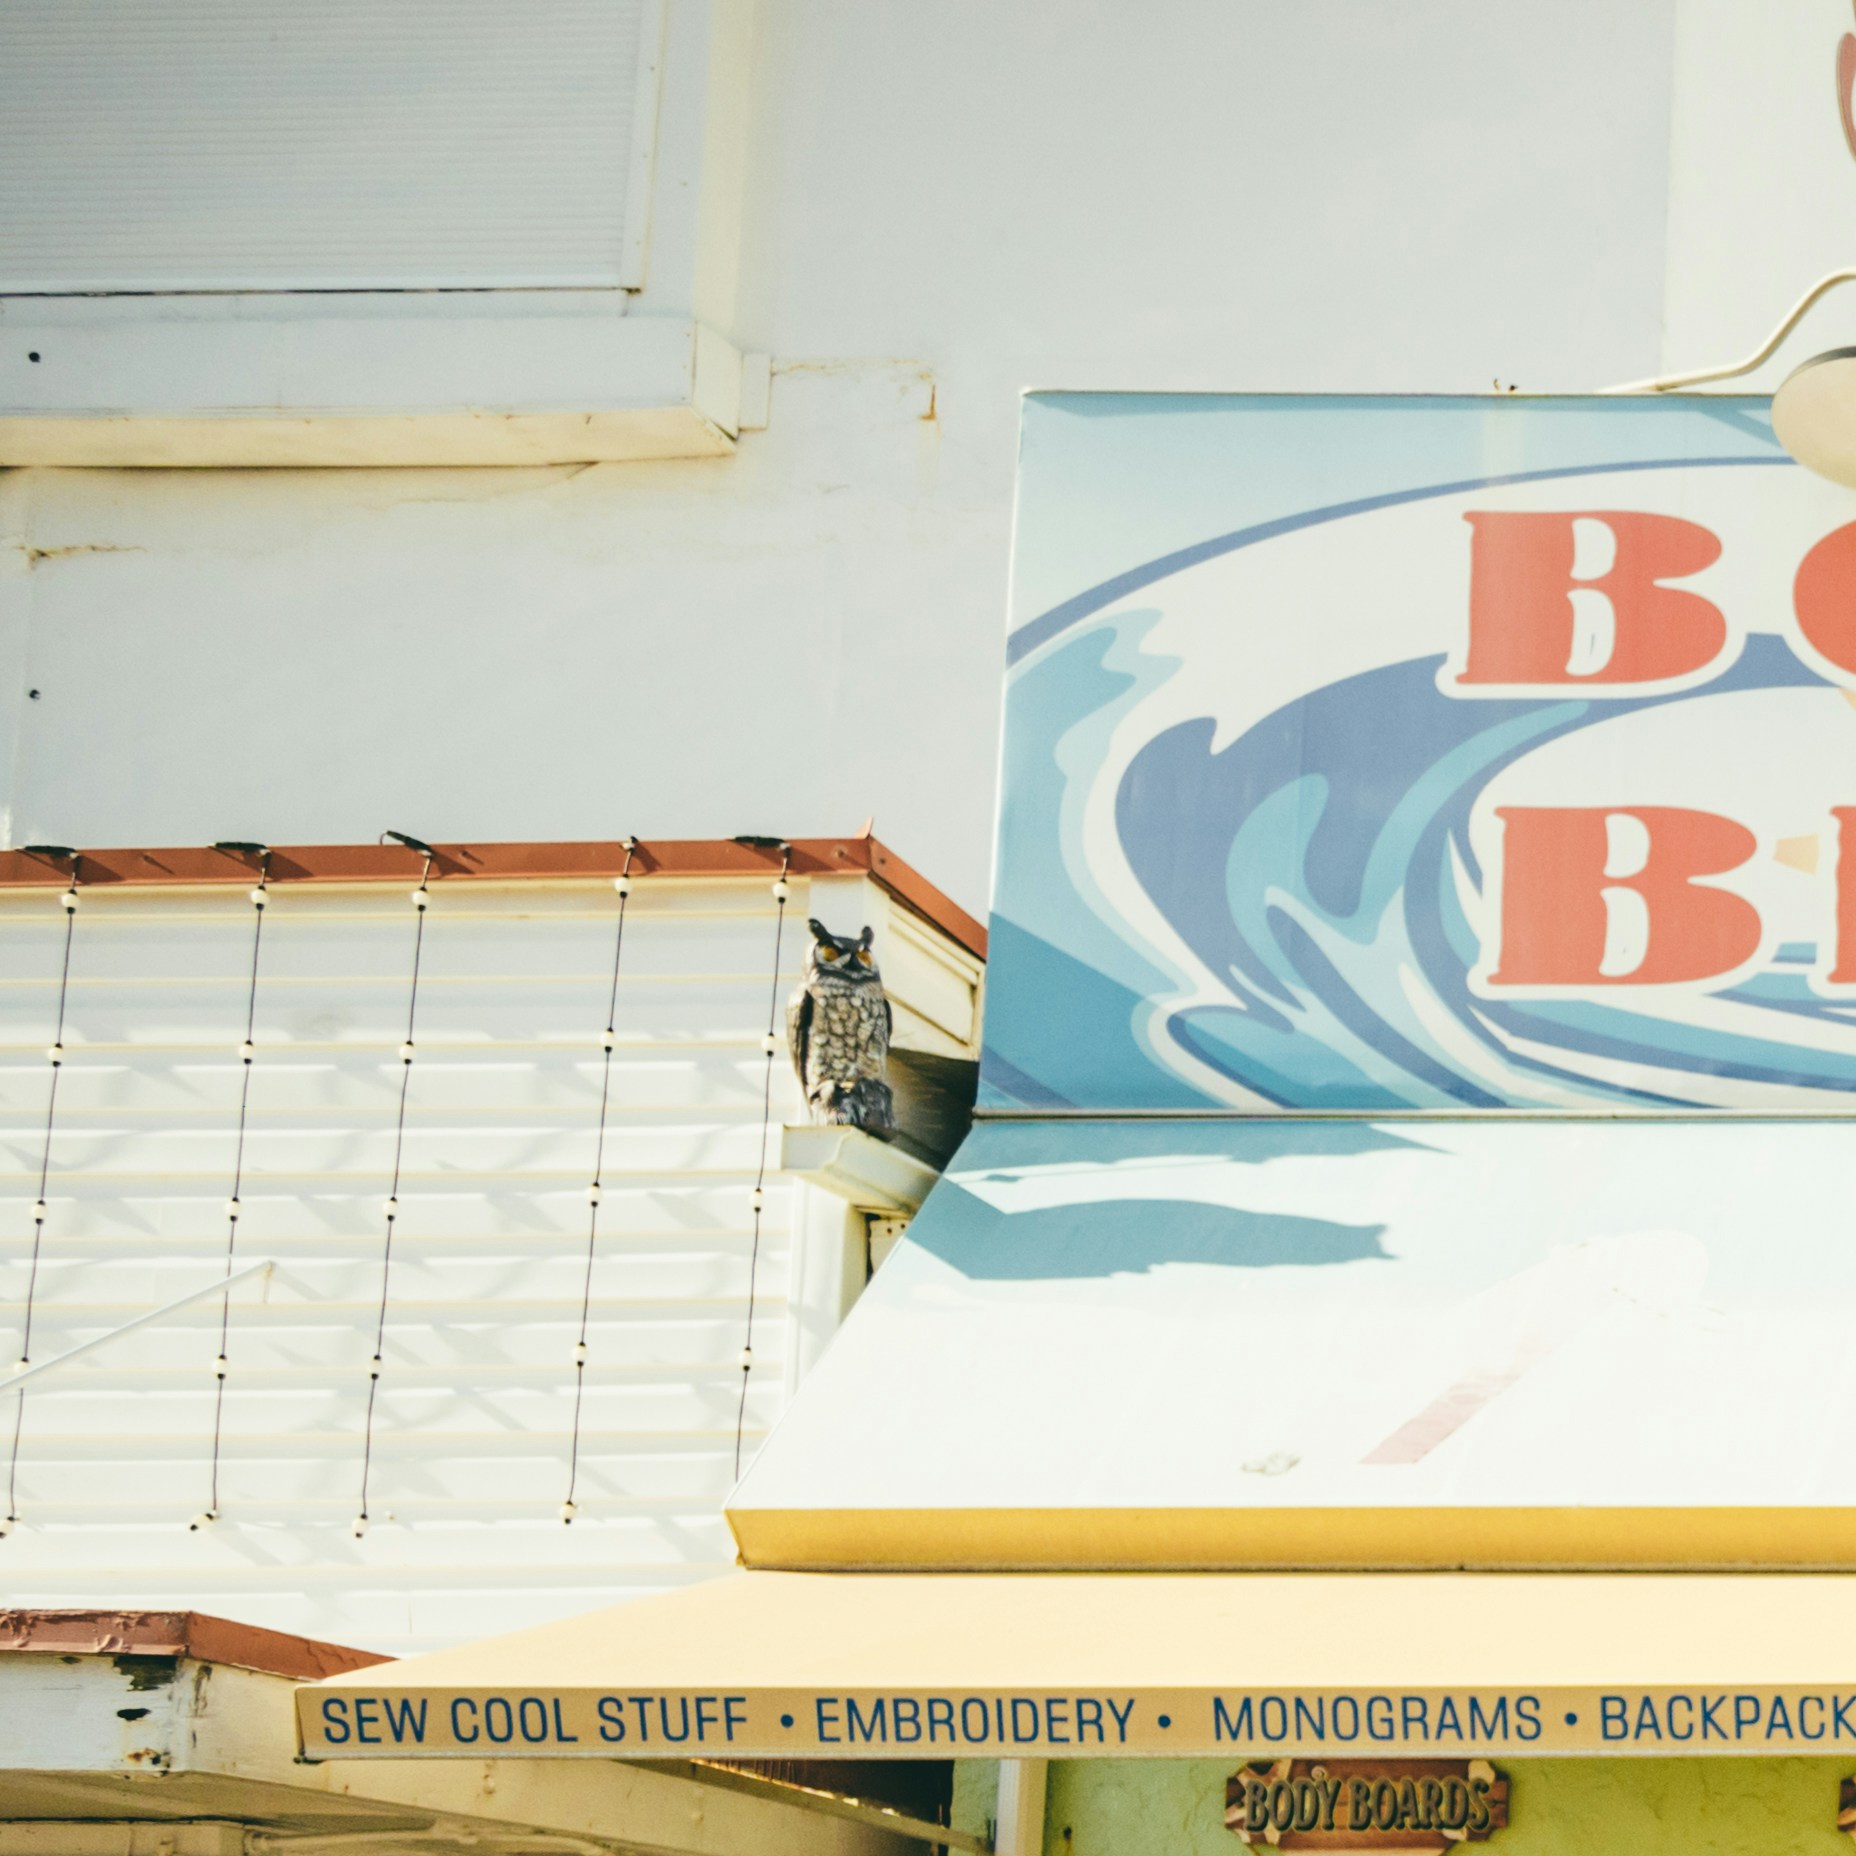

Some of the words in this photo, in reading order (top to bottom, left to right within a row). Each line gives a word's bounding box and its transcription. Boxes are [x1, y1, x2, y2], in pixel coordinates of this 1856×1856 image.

[322, 1697, 428, 1744] SEW
[450, 1696, 578, 1744] COOL
[597, 1696, 746, 1743] STUFF
[815, 1697, 1135, 1744] EMBROIDERY
[1212, 1695, 1543, 1742] MONOGRAMS
[1244, 1776, 1342, 1832] BODY
[1348, 1776, 1491, 1832] BOARDS
